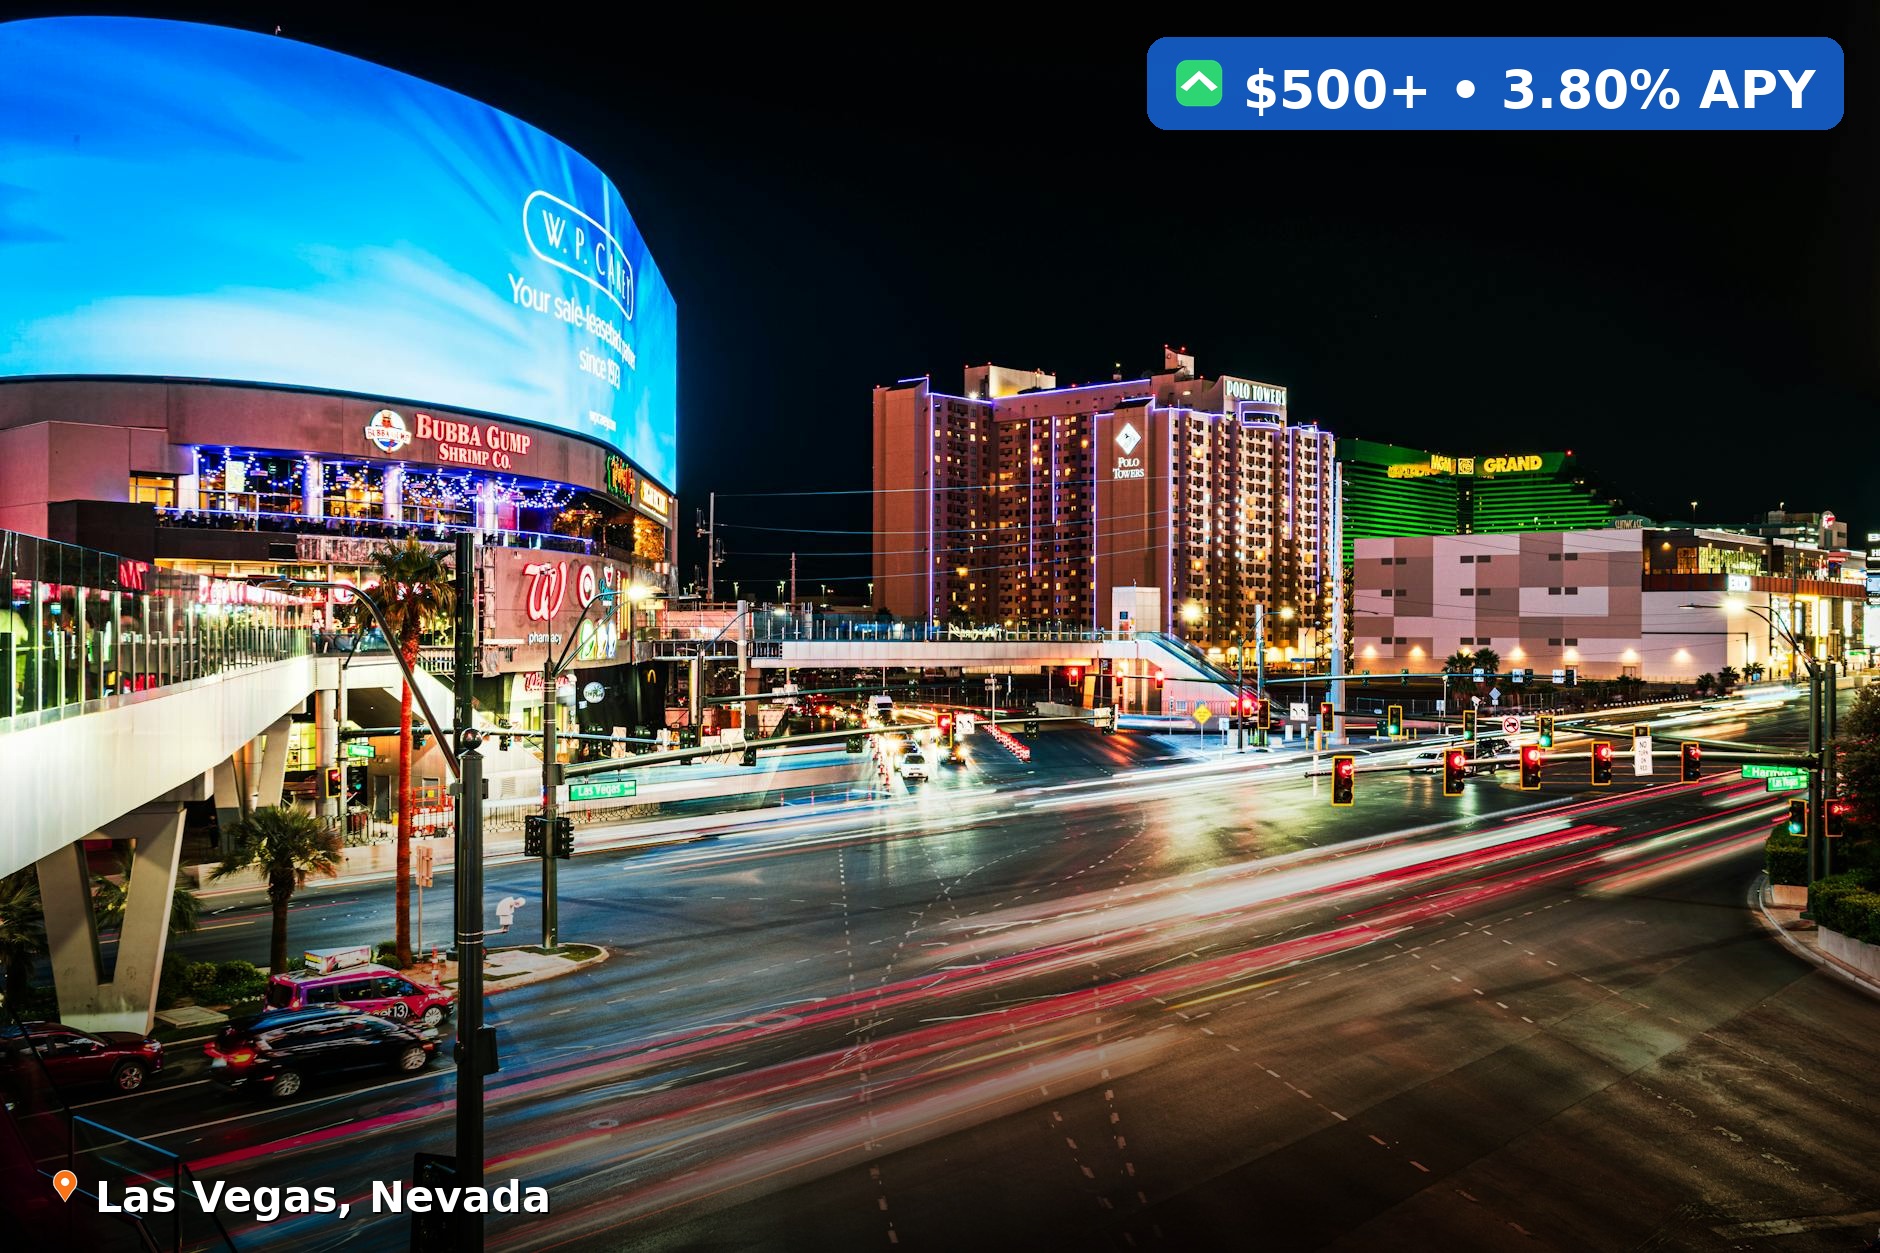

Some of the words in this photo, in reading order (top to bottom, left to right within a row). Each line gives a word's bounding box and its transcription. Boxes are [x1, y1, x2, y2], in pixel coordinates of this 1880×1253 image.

[508, 272, 551, 313] Your
[579, 347, 606, 380] since
[1226, 380, 1251, 400] POLO
[1251, 384, 1287, 406] TOWERS
[415, 413, 482, 447] BUBBA
[486, 425, 531, 455] GUMP
[439, 443, 489, 466] SHRIMP
[491, 450, 512, 470] CO.
[1117, 456, 1141, 468] POLO
[1431, 454, 1453, 473] MGM
[1483, 455, 1543, 473] GRAND
[1112, 467, 1145, 480] TOWERS
[528, 631, 563, 646] pharmacy
[1639, 741, 1648, 749] NO
[578, 785, 593, 797] Las
[595, 783, 621, 797] Vegas
